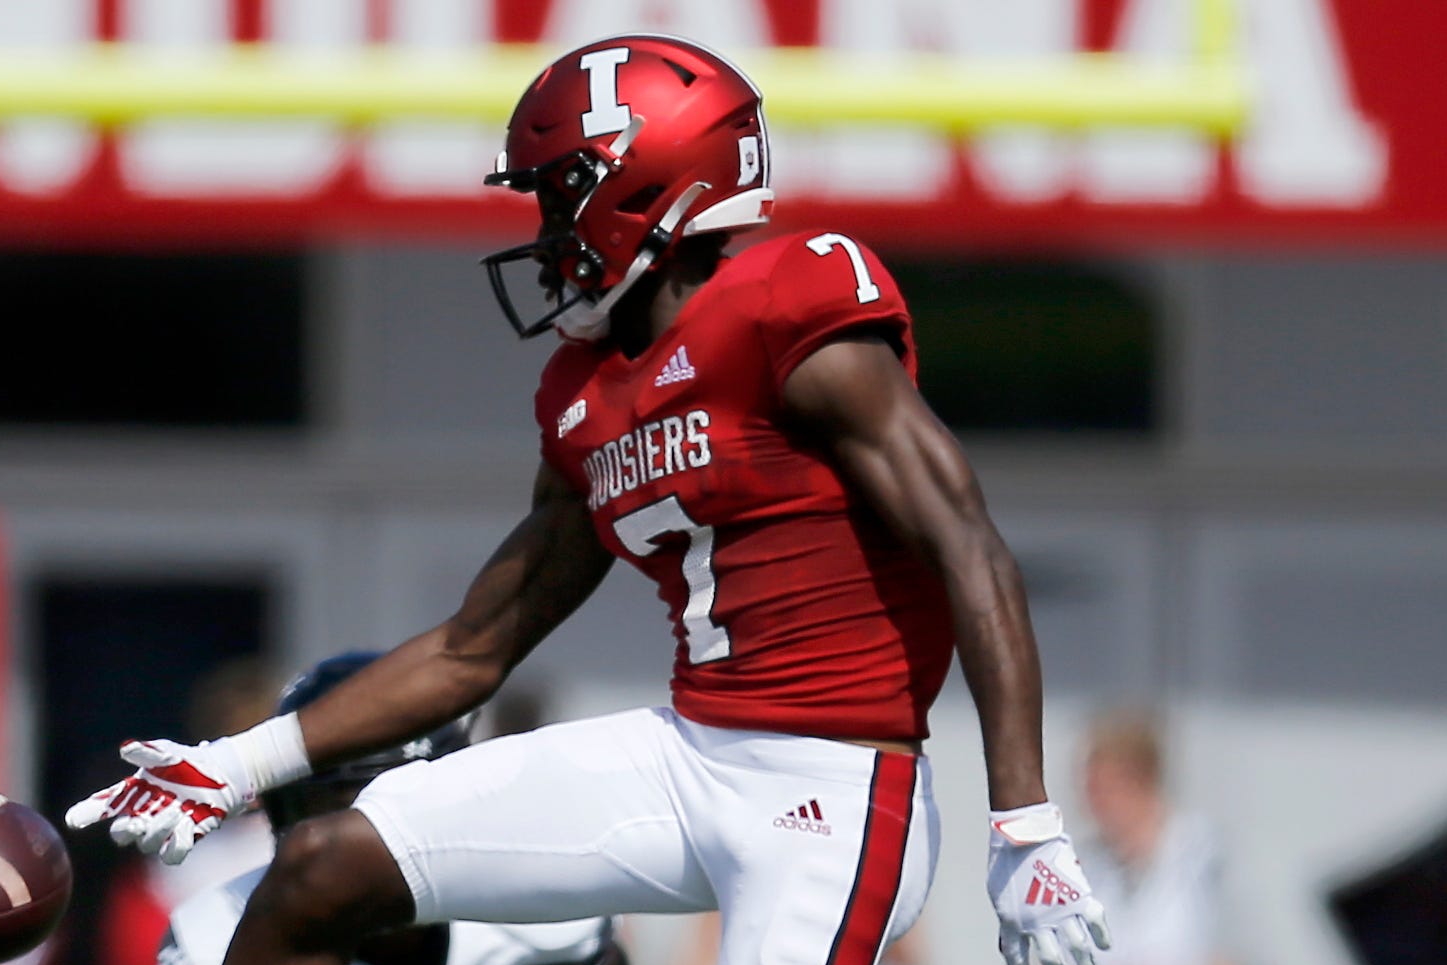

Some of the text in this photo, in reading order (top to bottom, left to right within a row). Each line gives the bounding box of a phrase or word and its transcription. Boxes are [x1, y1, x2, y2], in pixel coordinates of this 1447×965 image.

[579, 47, 632, 139] I
[805, 232, 881, 305] 7
[654, 365, 696, 388] adidas
[612, 495, 731, 665] 7
[772, 816, 831, 837] adidas
[1033, 858, 1080, 903] adidas
